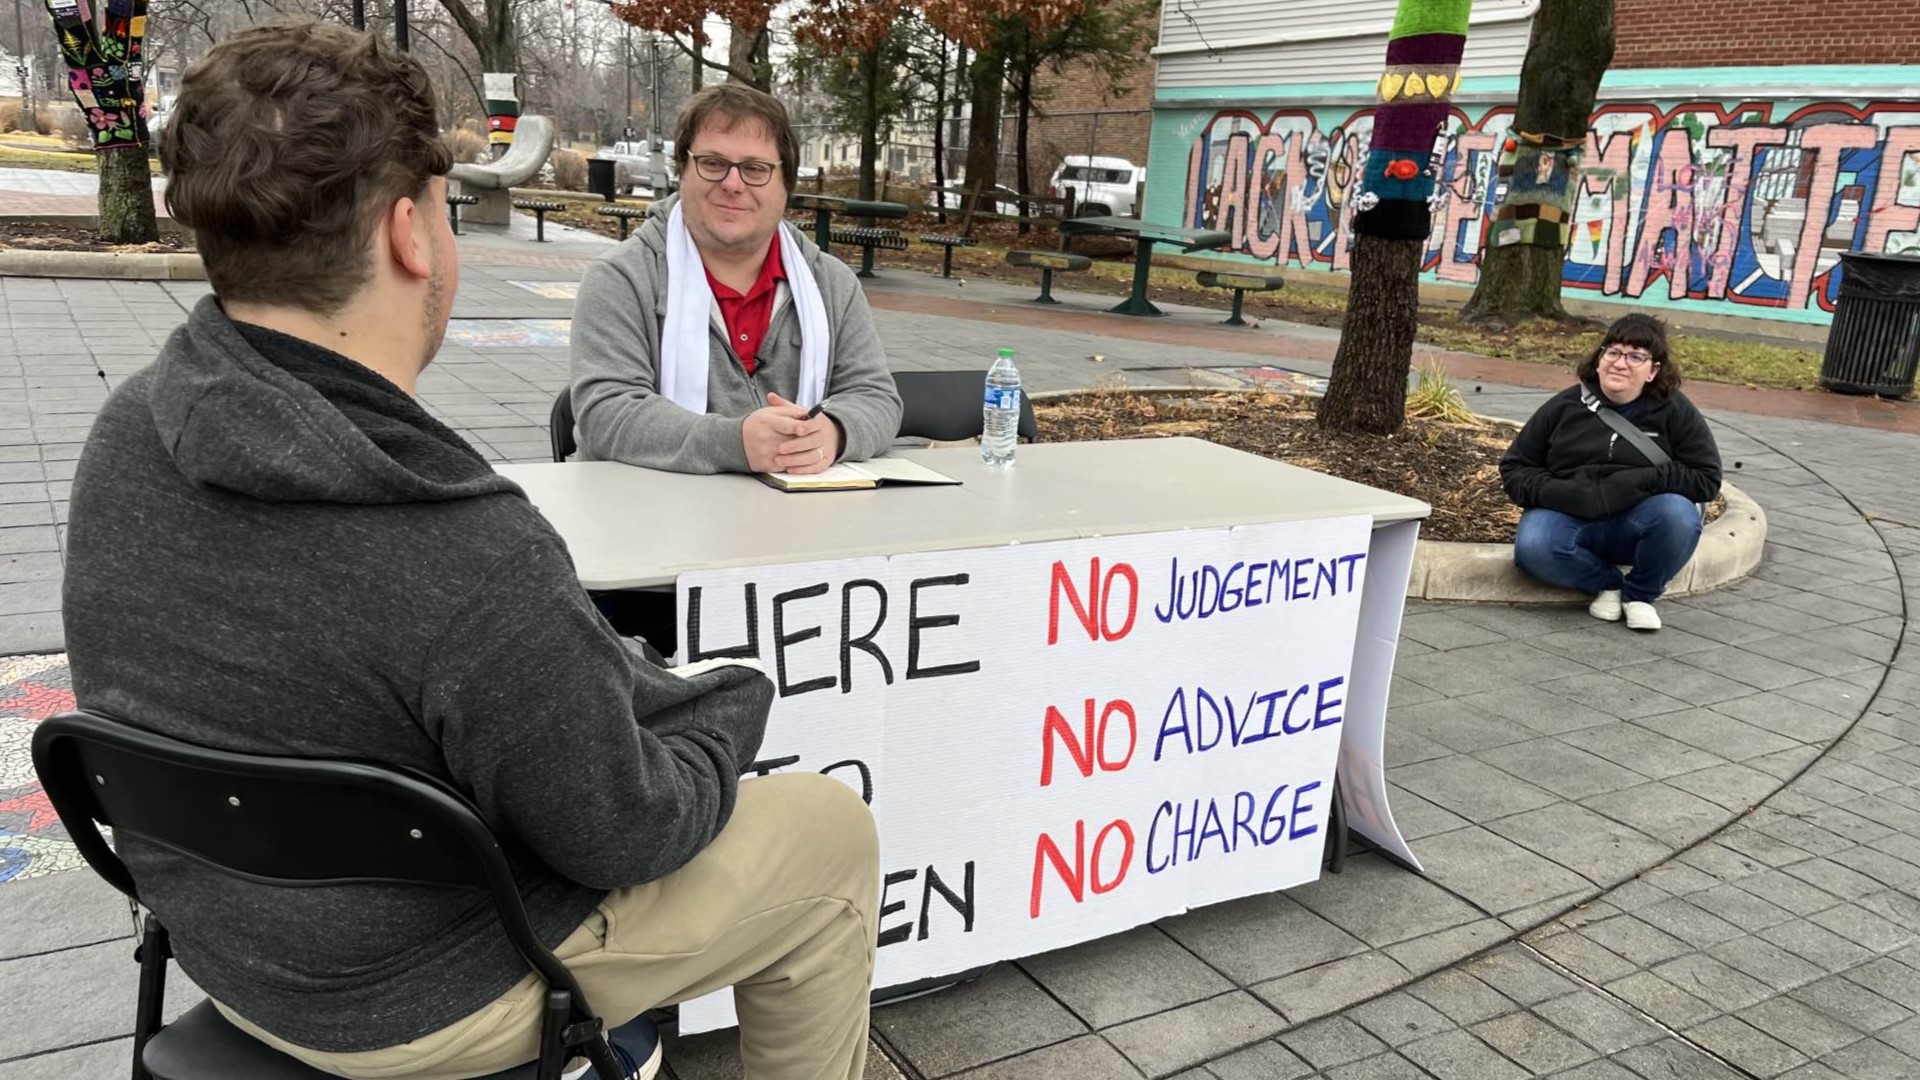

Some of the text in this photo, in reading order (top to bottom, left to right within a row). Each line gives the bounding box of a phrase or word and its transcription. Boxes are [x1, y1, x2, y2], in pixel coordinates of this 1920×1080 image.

[686, 573, 981, 698] HERE
[1047, 553, 1367, 645] NO JUDGEMENT
[1040, 676, 1344, 787] NO ADVICE
[1030, 819, 1135, 919] NO
[1145, 781, 1322, 874] CHARGE
